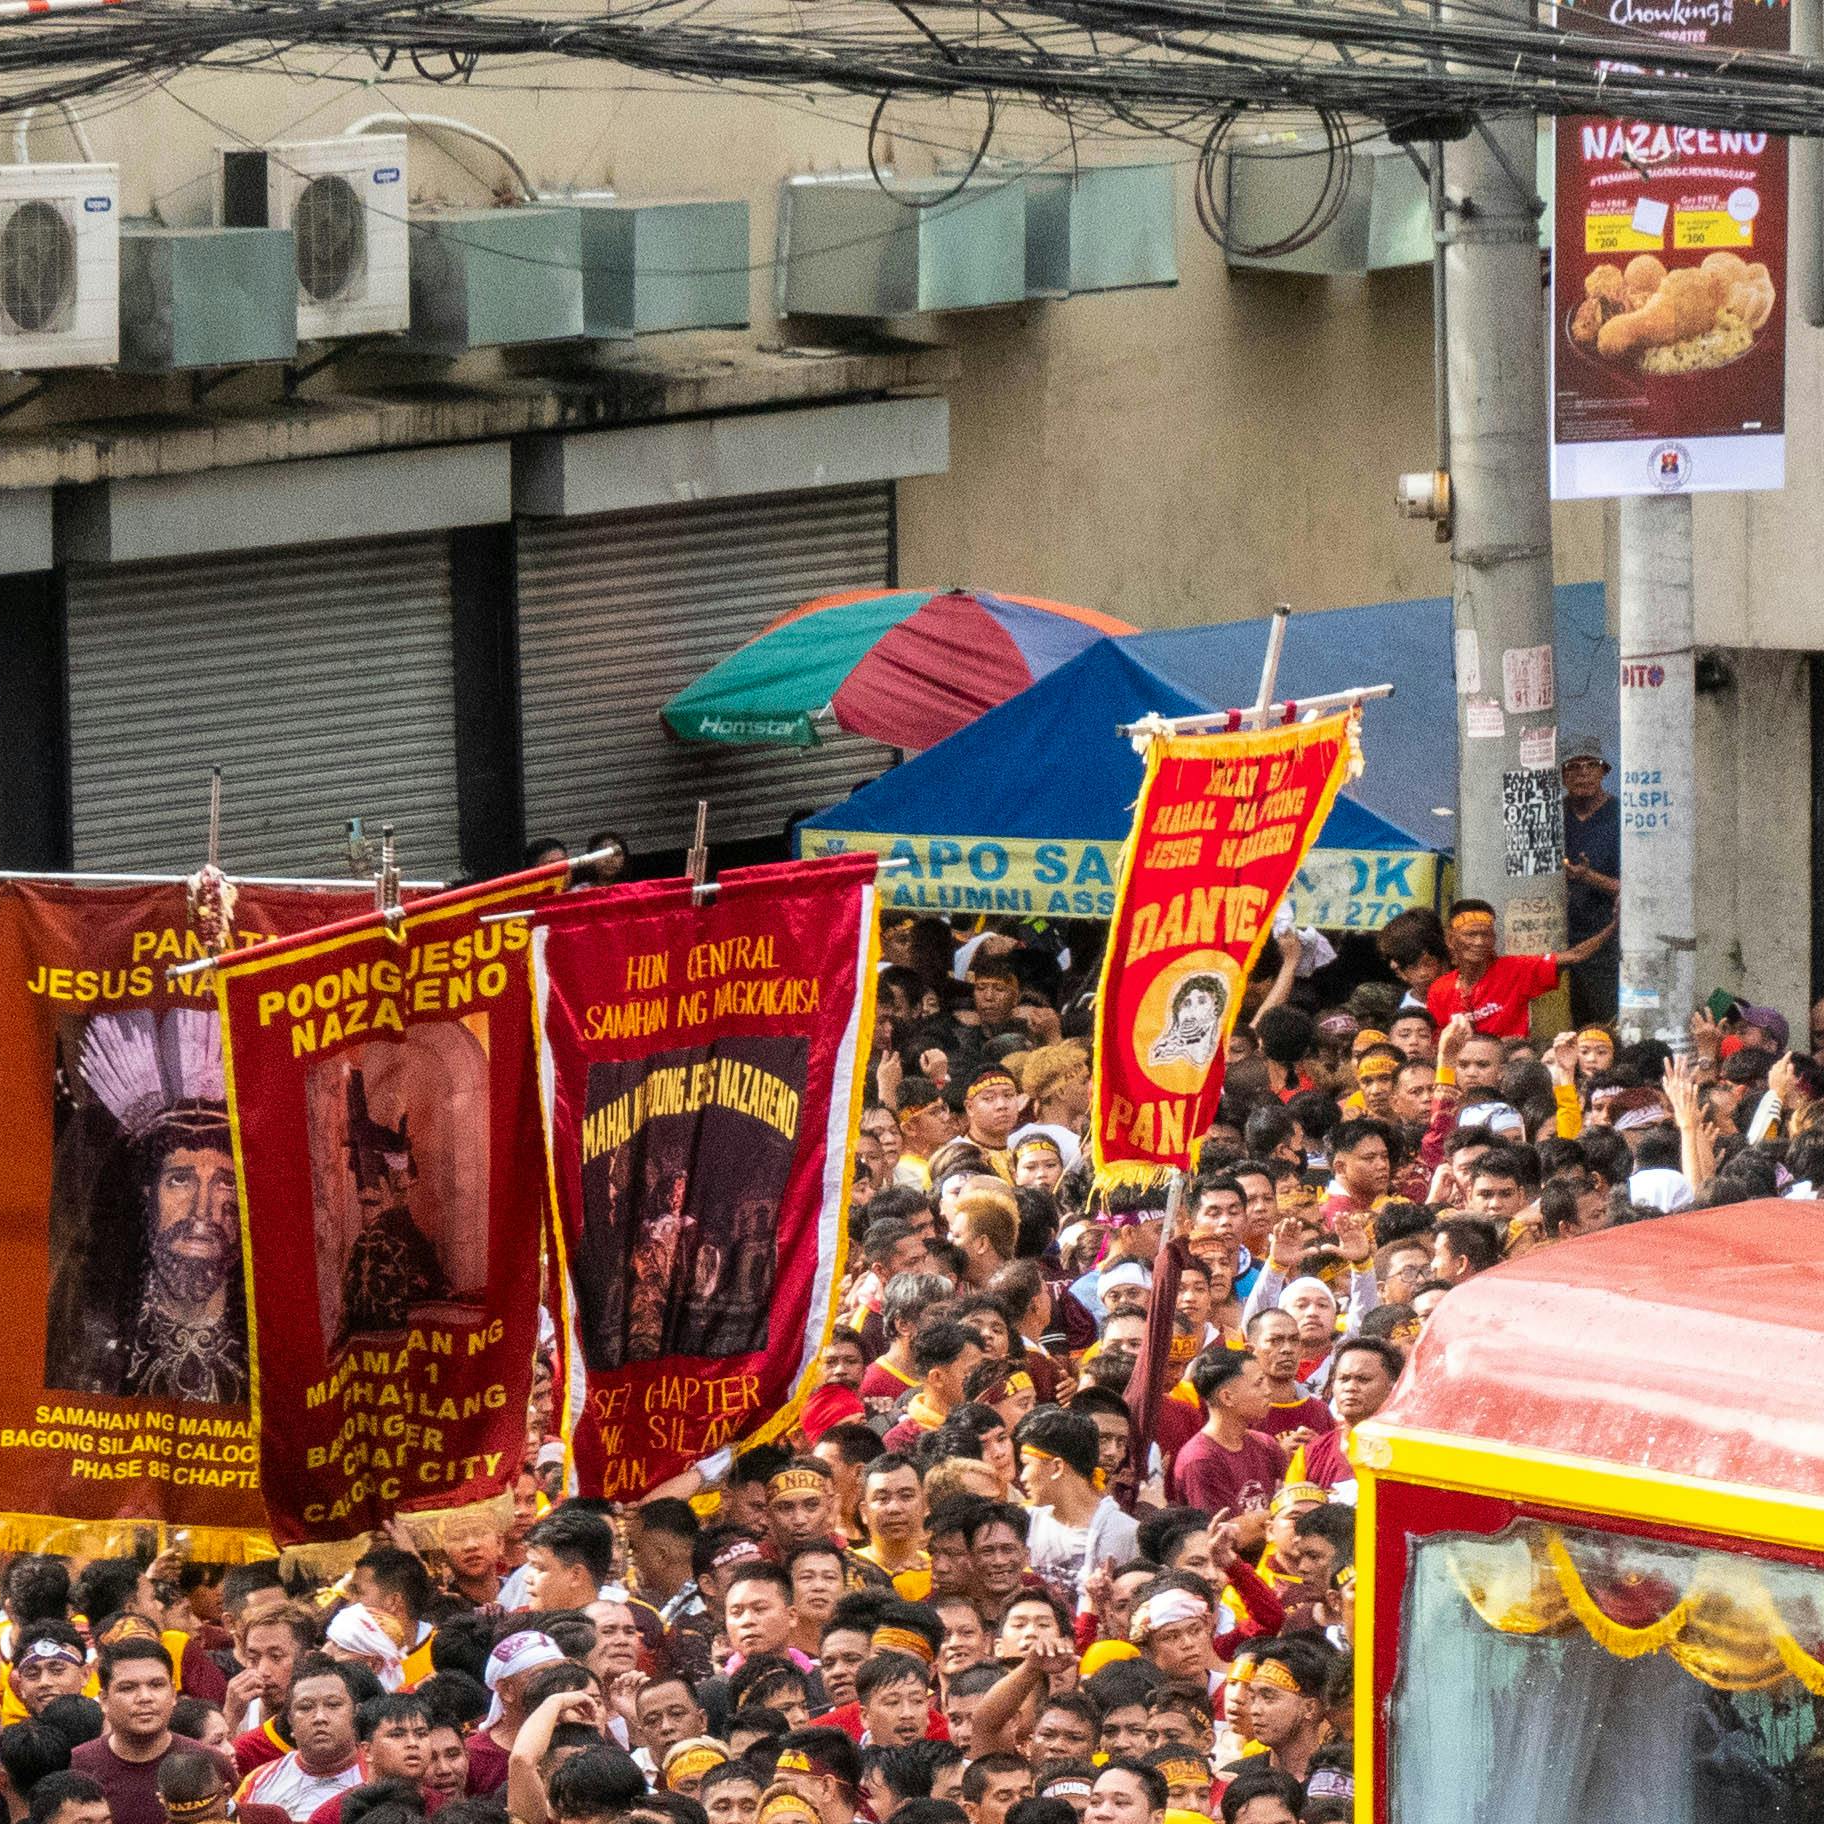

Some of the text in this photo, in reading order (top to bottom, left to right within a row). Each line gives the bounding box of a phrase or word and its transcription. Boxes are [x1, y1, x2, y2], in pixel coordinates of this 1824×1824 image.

[1610, 0, 1720, 26] Chowking
[1581, 122, 1768, 161] NAZARENO
[1624, 771, 1662, 784] 2022
[1144, 836, 1203, 869] JESUS
[893, 883, 1033, 914] ALUMNI
[258, 917, 531, 1028] POONG JESUS
[686, 935, 781, 982] CENTRAL
[27, 965, 154, 1002] JESUS
[291, 962, 508, 1058] NAZAENO
[583, 995, 668, 1041] SAMAHAN
[676, 990, 708, 1028] NG
[716, 1058, 799, 1141] NAZARENO
[467, 1318, 504, 1356] NG
[35, 1404, 140, 1431] SAMAHAN
[145, 1410, 175, 1430] NG
[0, 1429, 95, 1452] BAGONG
[97, 1433, 173, 1456] SILANG
[71, 1457, 143, 1481] PHASE
[419, 1451, 504, 1483] CITY
